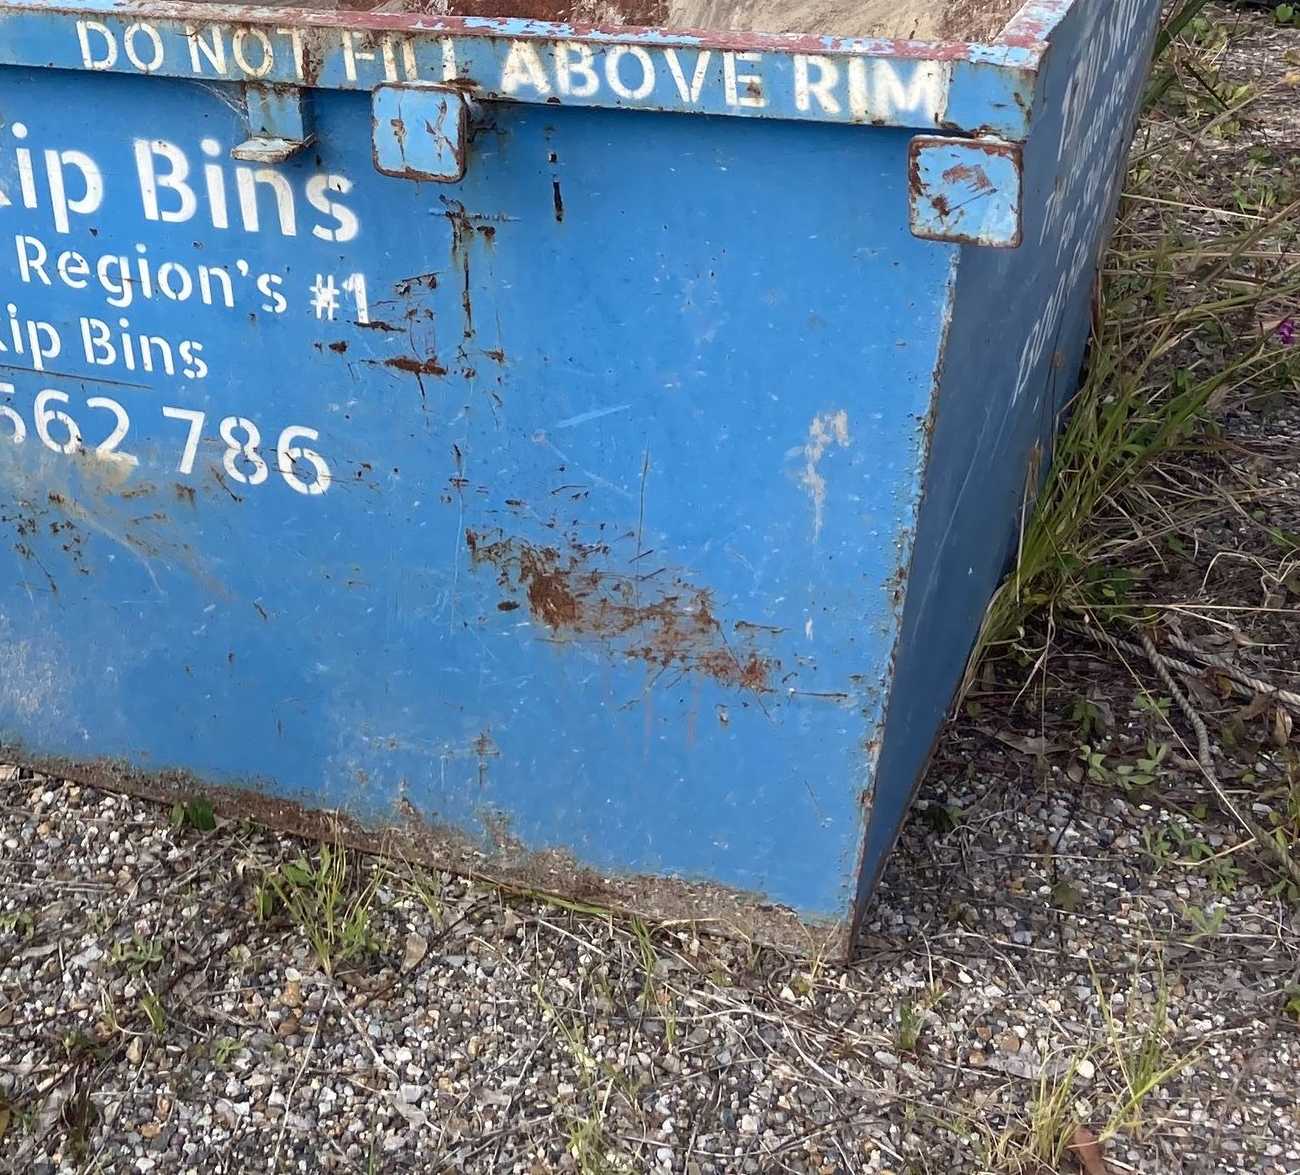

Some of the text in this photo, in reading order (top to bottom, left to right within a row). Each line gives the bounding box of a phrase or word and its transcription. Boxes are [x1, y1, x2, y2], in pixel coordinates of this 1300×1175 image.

[76, 19, 166, 73] DO
[188, 25, 304, 83] NOT
[503, 38, 767, 109] ABOVE
[793, 53, 945, 123] RIM
[133, 133, 363, 242] Bins
[16, 234, 288, 314] Region's
[308, 272, 371, 325] #1
[83, 316, 208, 380] Bins
[161, 406, 333, 496] 786
